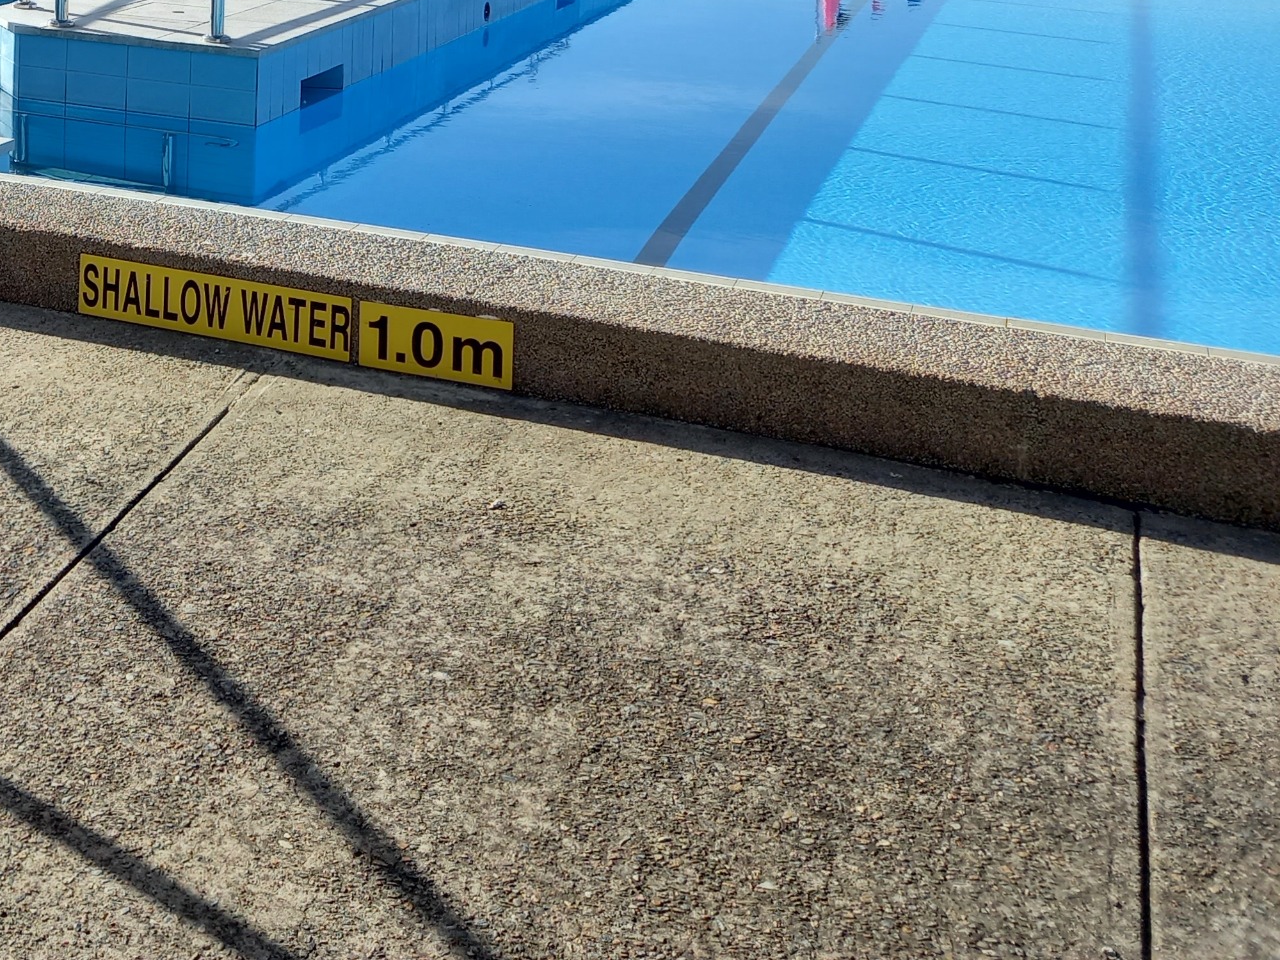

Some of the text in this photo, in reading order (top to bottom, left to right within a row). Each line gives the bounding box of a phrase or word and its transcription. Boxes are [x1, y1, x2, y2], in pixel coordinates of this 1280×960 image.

[82, 263, 351, 352] SHALLOW WATER
[368, 315, 503, 379] 1.0m
